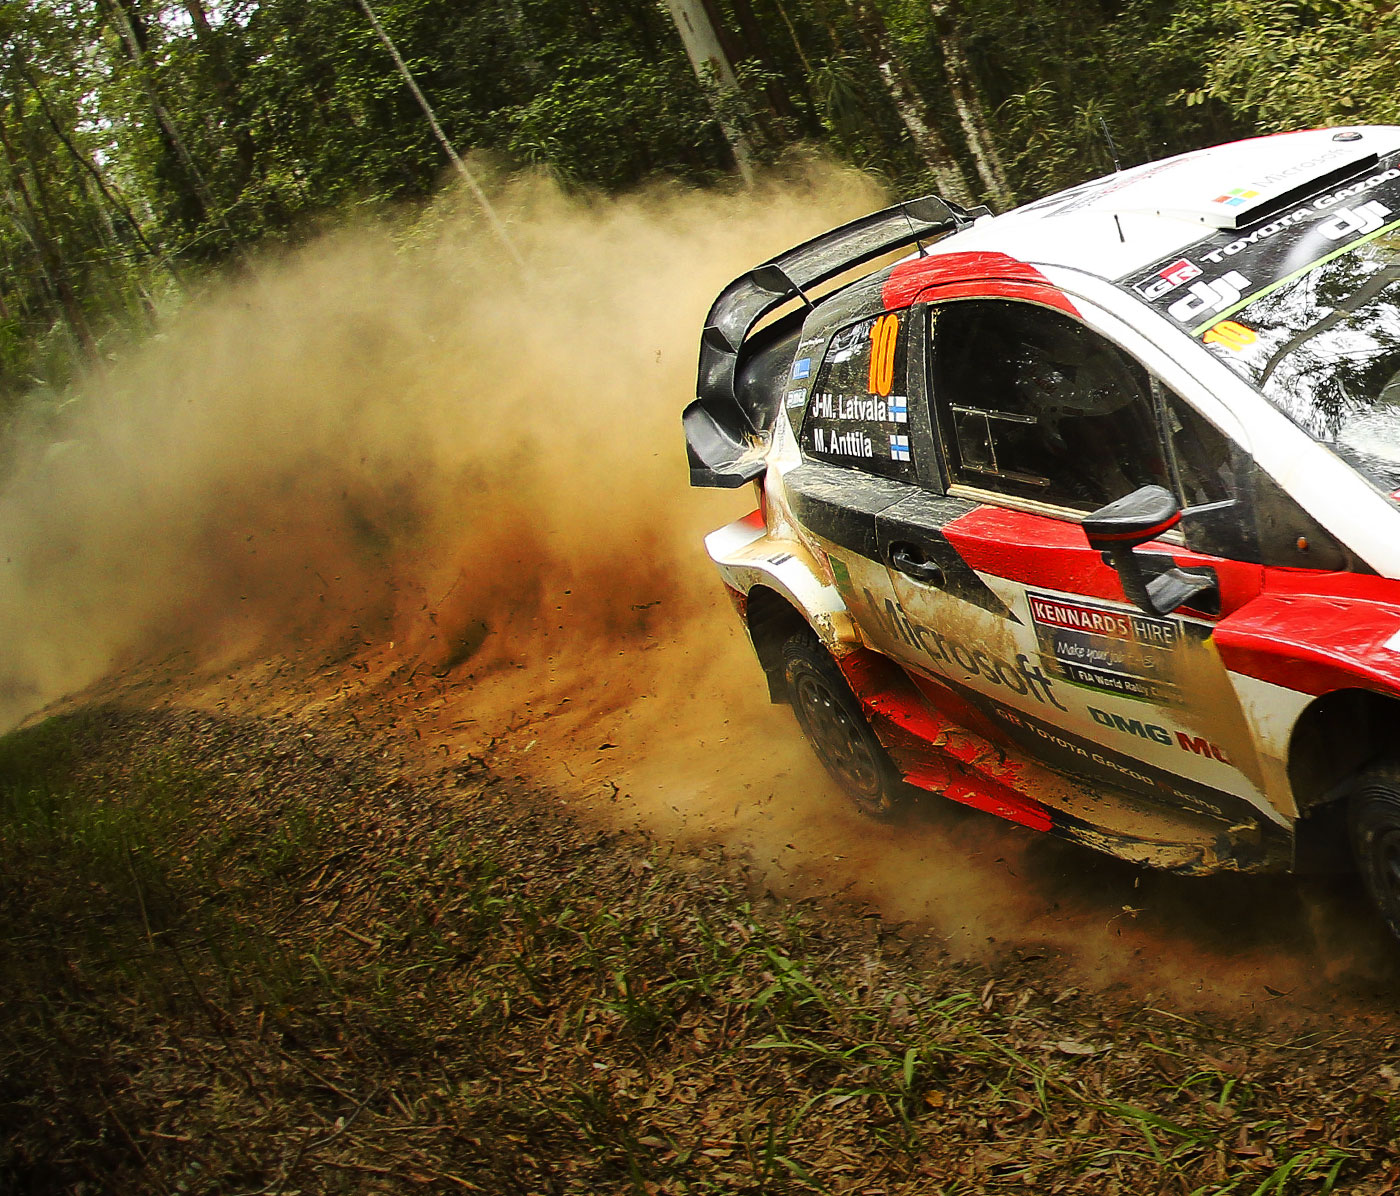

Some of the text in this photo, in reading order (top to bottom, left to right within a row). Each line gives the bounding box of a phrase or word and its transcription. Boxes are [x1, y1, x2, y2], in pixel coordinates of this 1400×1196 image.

[1143, 266, 1199, 298] GR
[1200, 207, 1314, 263] TOYOTA
[1202, 319, 1257, 351] 10
[868, 313, 899, 397] 10
[812, 393, 837, 420] J-M.
[838, 394, 887, 422] Latvala
[813, 428, 828, 454] M.
[830, 430, 873, 458] Anttila
[1033, 601, 1173, 644] KENNARDS HIRE
[862, 586, 1068, 712] Microsoft
[1056, 641, 1086, 659] Make
[1086, 646, 1108, 663] your
[1078, 669, 1095, 683] FIA
[1096, 673, 1123, 689] World
[1024, 721, 1089, 758] TOYOTA
[1086, 705, 1173, 746] DMG
